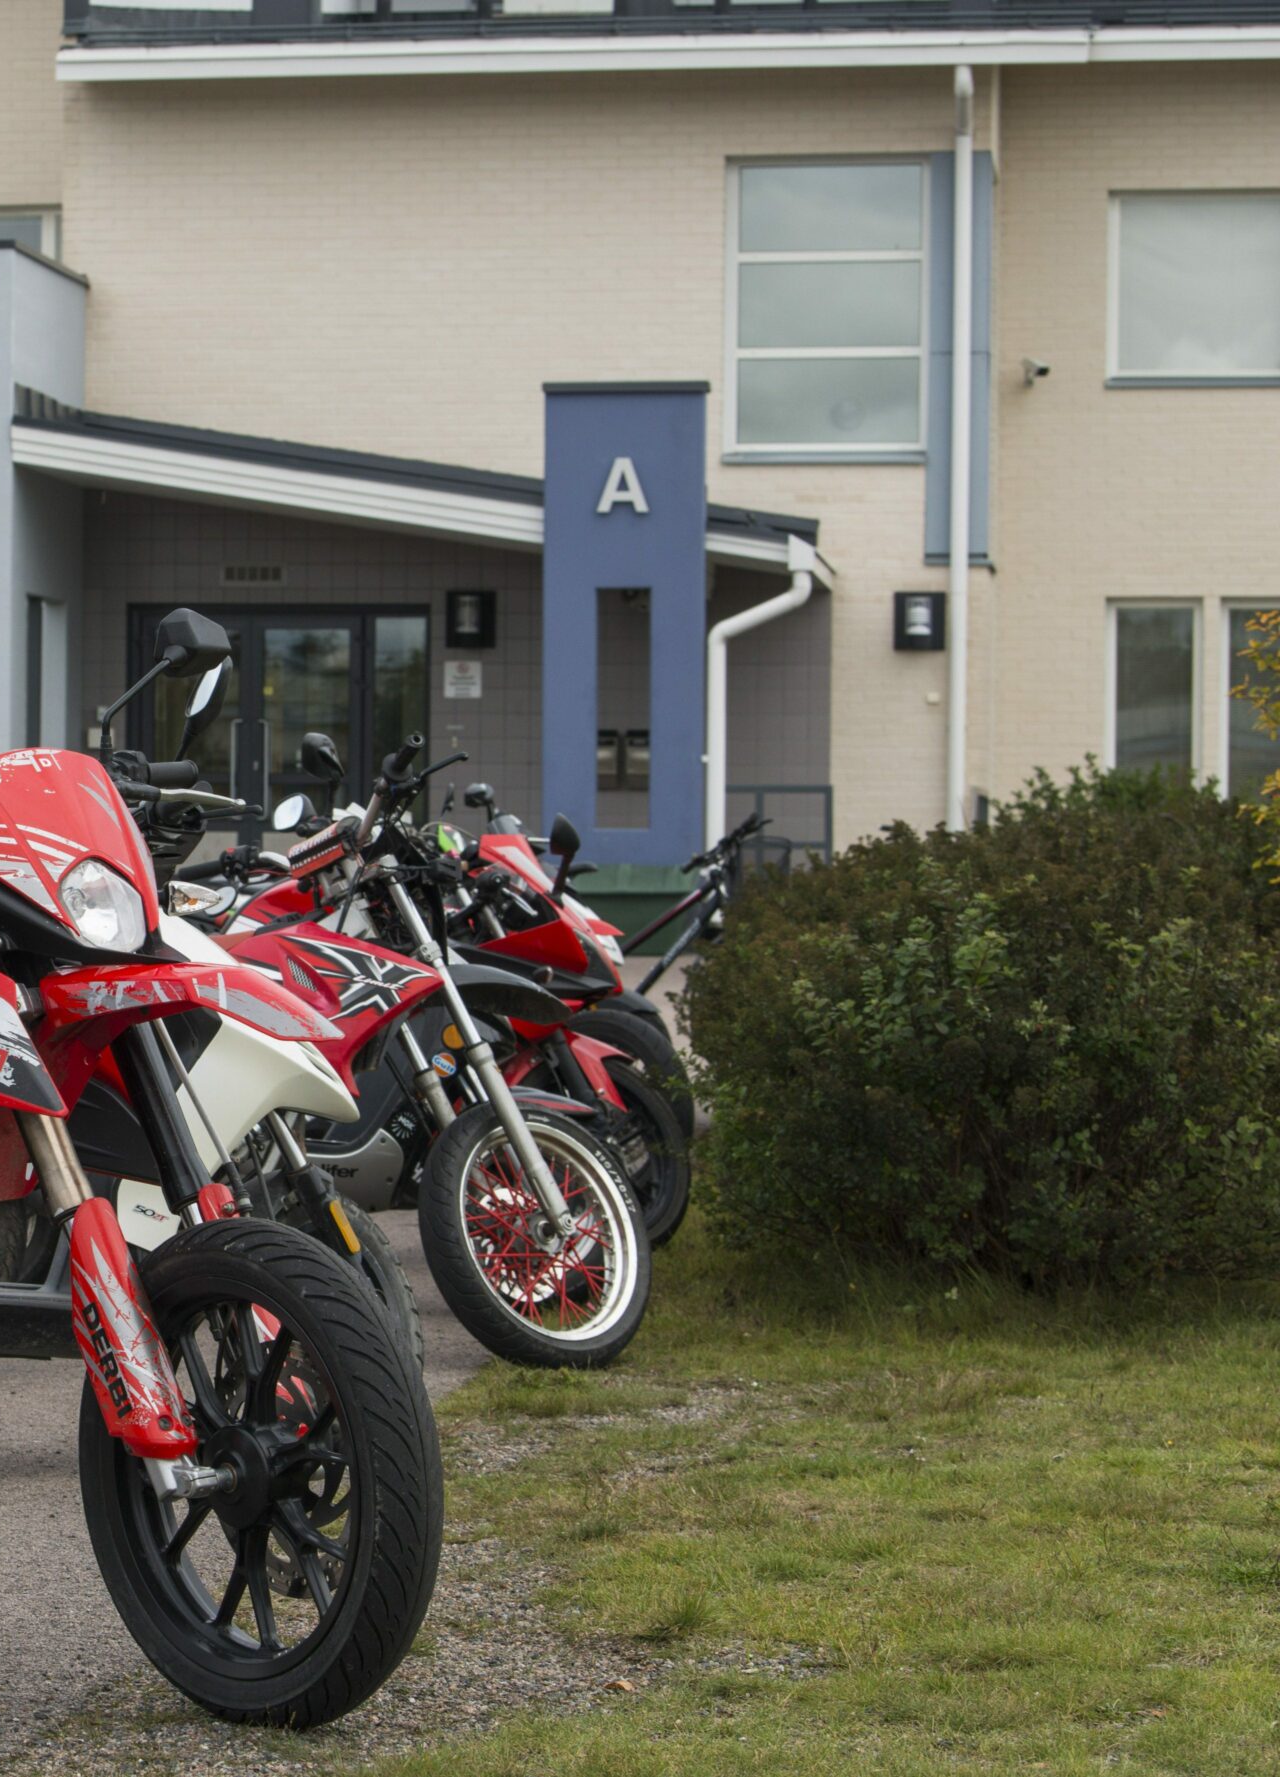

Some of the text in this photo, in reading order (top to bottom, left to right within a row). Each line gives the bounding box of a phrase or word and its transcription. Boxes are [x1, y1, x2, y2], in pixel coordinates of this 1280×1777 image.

[596, 457, 650, 513] A
[594, 1150, 637, 1213] 110/70-17
[82, 1302, 133, 1418] DERBI
